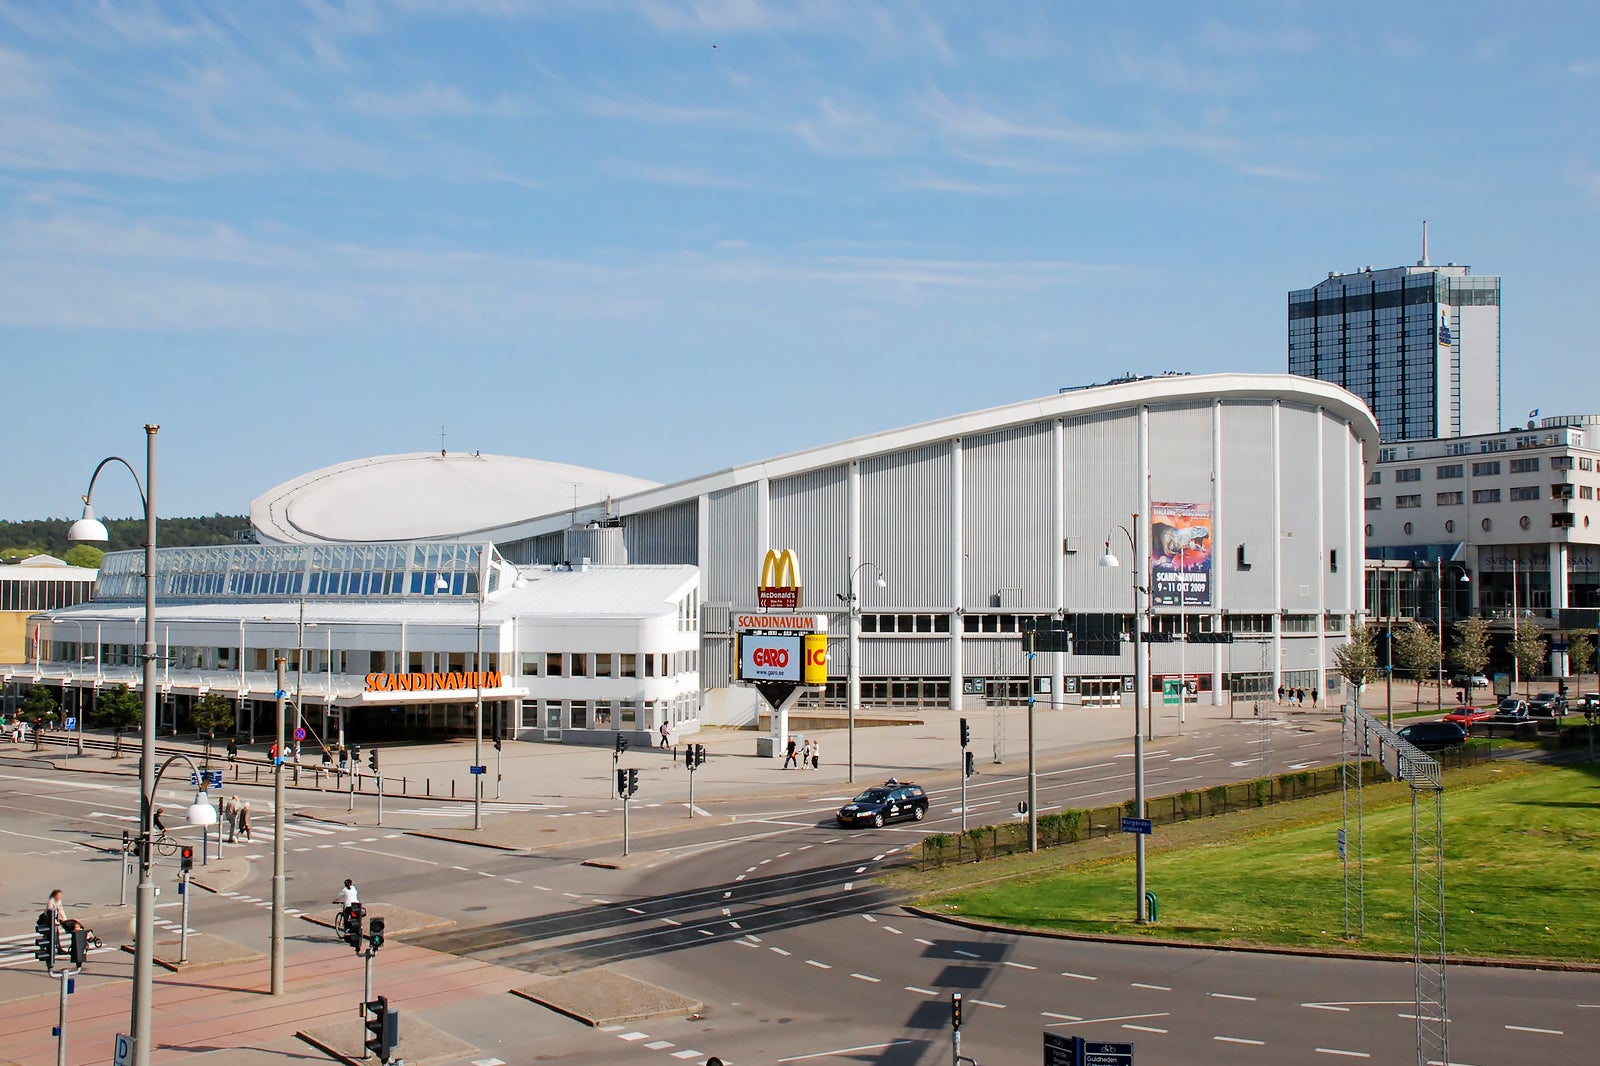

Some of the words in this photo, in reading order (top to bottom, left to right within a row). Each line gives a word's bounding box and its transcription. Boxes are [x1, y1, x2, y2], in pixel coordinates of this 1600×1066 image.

[1156, 572, 1207, 582] SCANDAVIUM
[1158, 583, 1162, 592] 9
[1168, 583, 1175, 592] 11
[1191, 583, 1206, 592] 2009
[738, 615, 814, 629] SCANDINAVIUM
[753, 648, 789, 668] GARO
[756, 669, 784, 677] www.garo.se
[365, 671, 502, 692] SCANDINAVIUM
